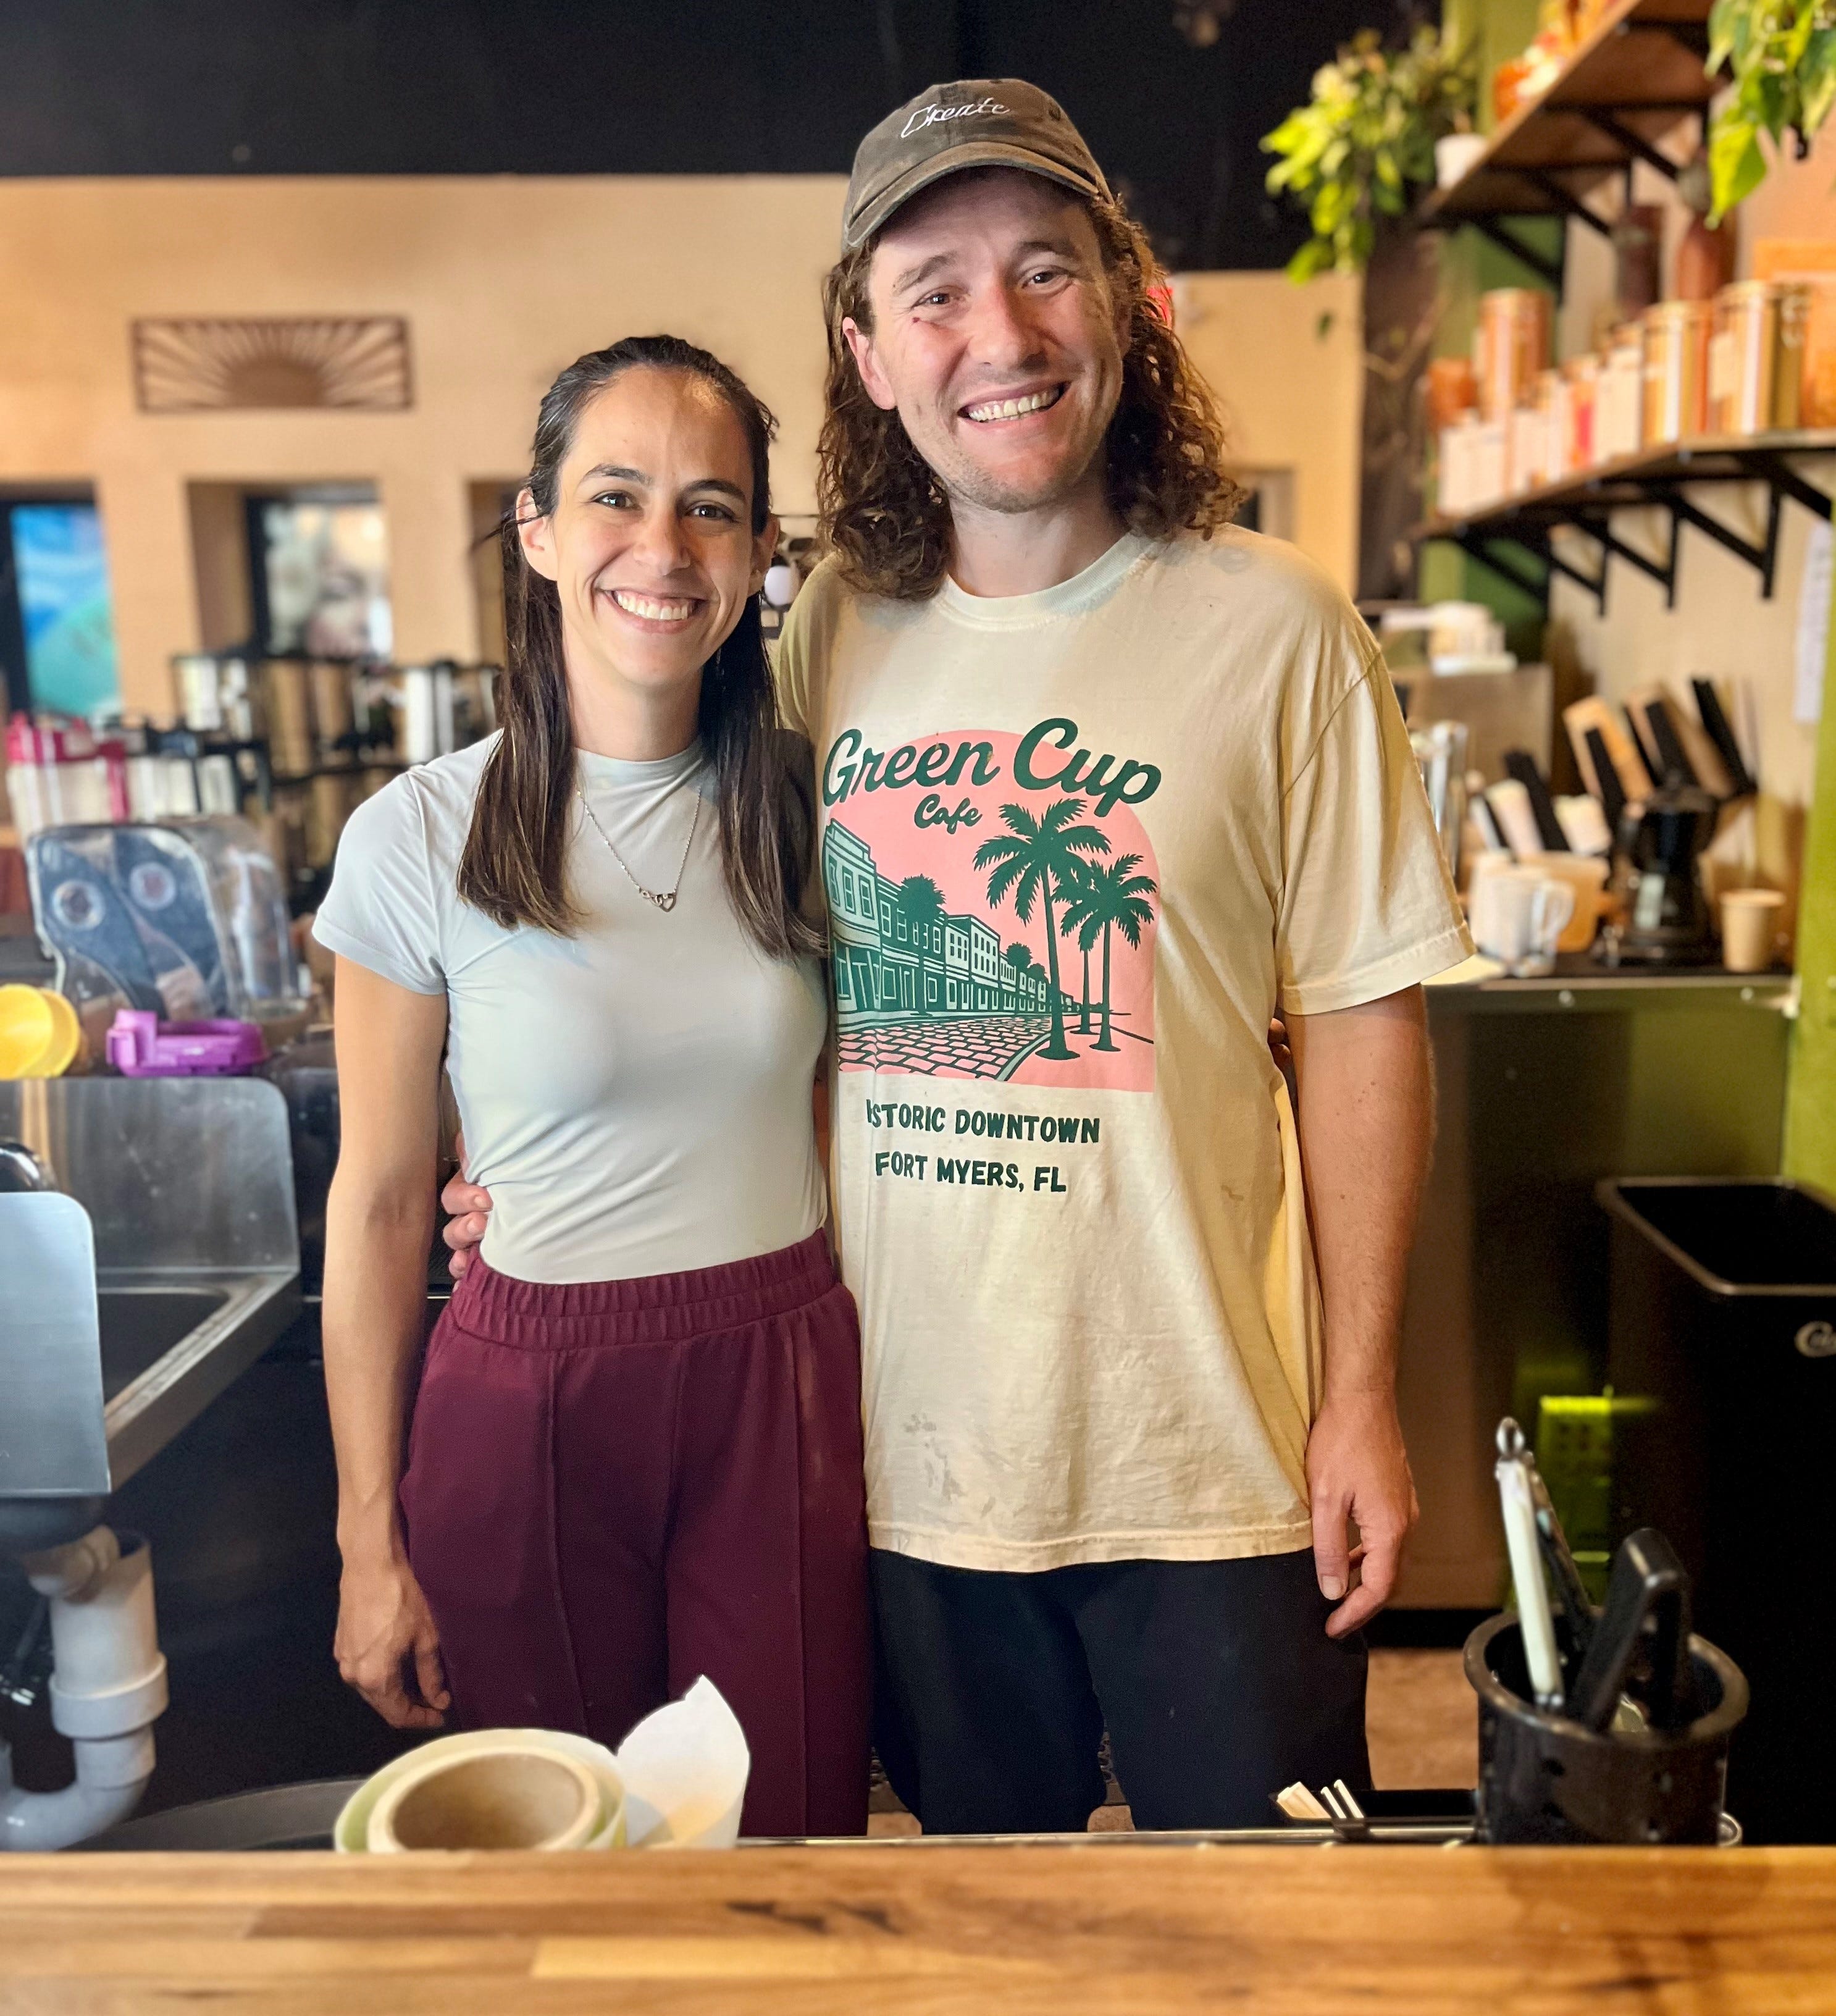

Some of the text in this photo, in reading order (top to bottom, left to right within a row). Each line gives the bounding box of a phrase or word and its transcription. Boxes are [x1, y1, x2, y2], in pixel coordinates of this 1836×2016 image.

[900, 97, 1010, 138] Create
[823, 717, 1162, 817] Green Cup
[914, 794, 983, 834] Cafe
[955, 1109, 1100, 1143] DOWNTOWN
[875, 1151, 1067, 1193] FORT MYERS, FL
